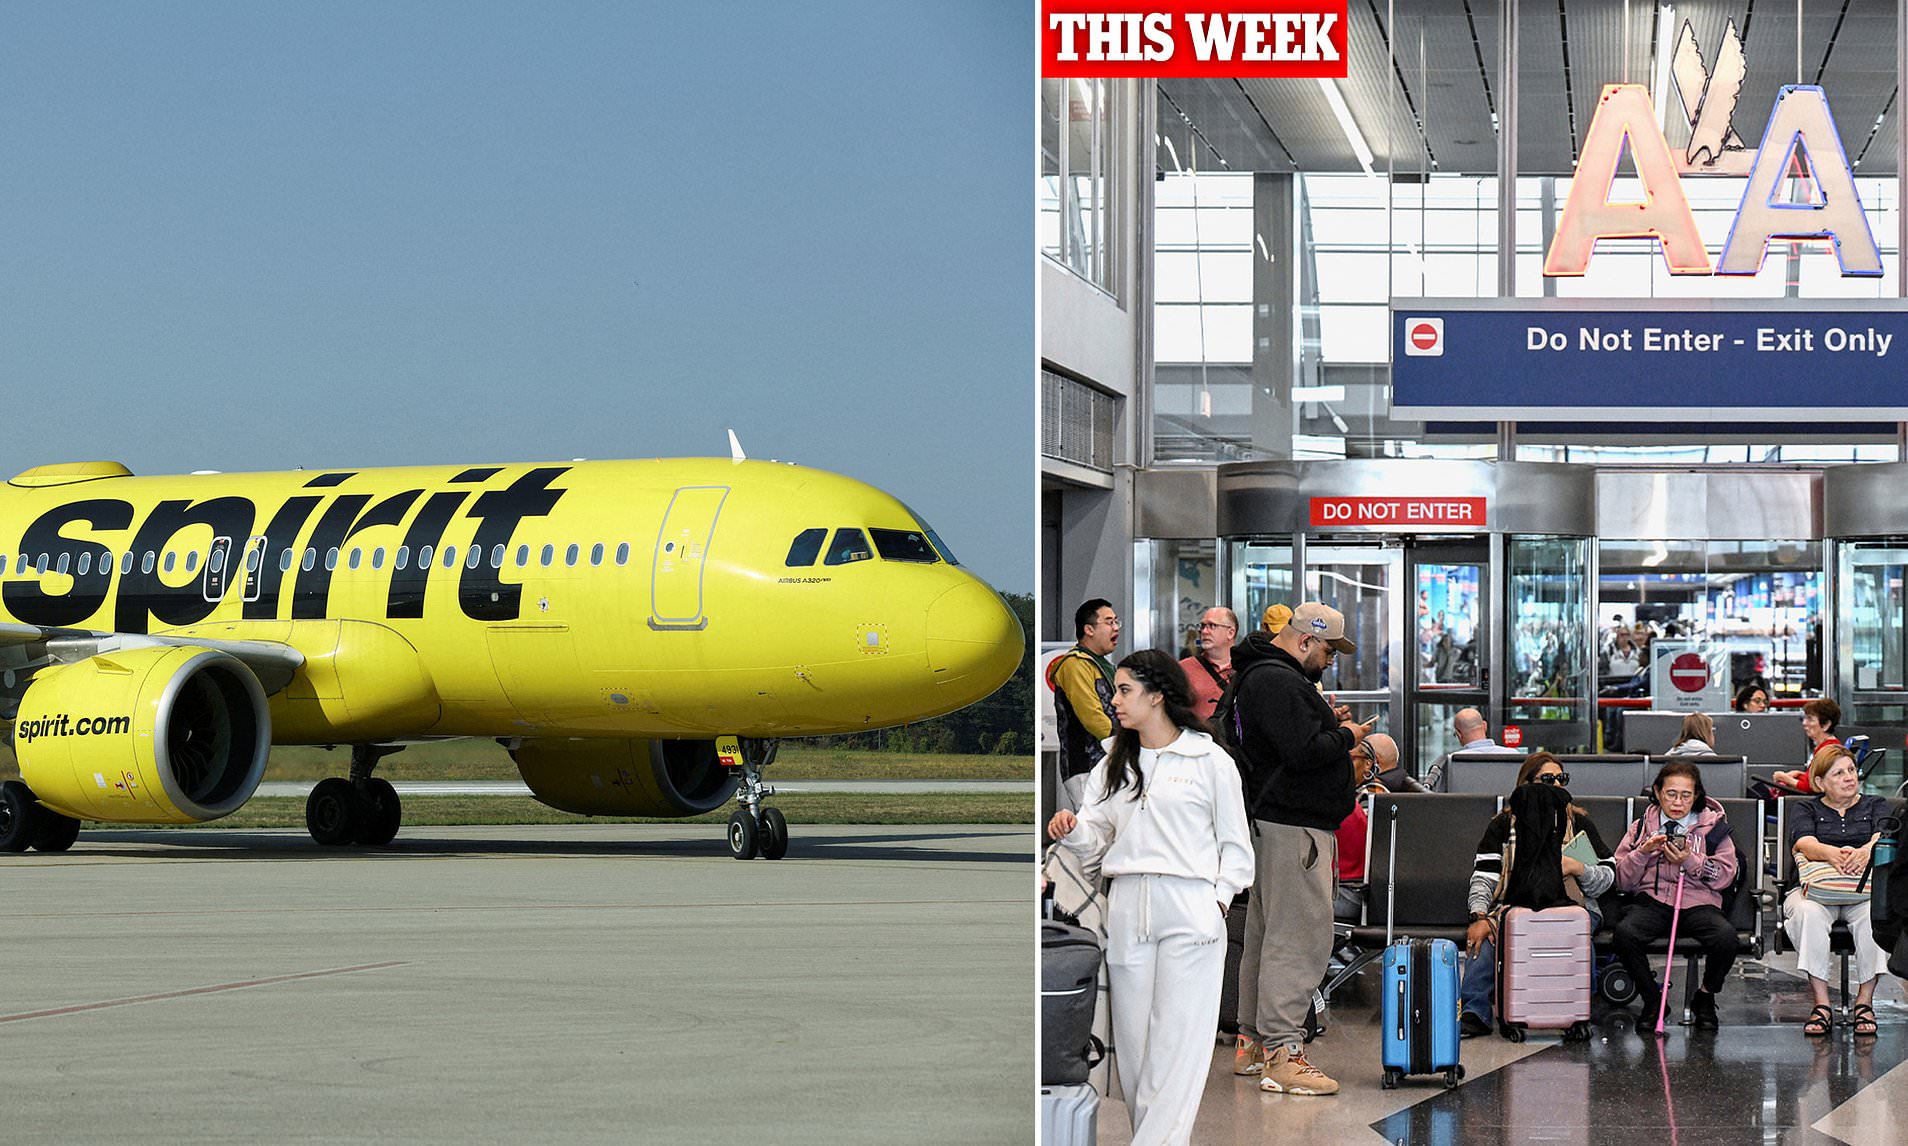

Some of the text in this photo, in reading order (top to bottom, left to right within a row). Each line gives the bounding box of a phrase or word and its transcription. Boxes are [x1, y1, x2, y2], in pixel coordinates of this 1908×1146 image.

[1526, 327, 1893, 357] Do Not Enter - Exit Only
[1323, 503, 1472, 520] DO NOT ENTER
[2, 467, 574, 634] spirit
[18, 713, 131, 743] spirit.com
